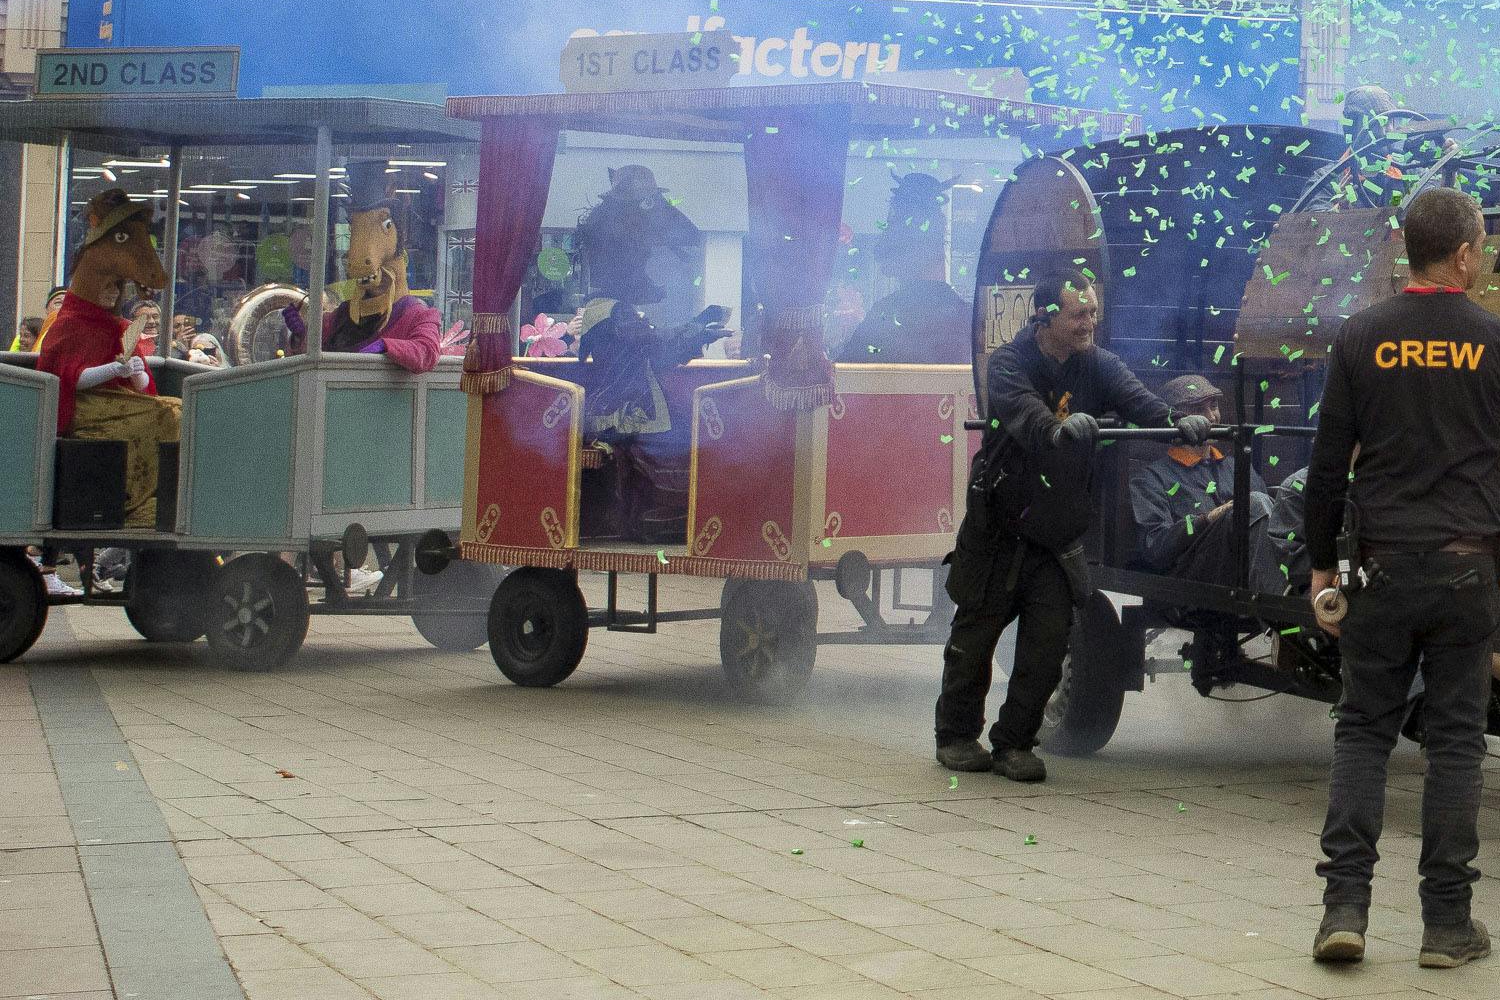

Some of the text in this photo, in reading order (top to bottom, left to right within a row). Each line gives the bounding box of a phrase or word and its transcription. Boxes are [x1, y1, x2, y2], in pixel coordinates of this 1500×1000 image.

[53, 61, 216, 86] 2ND CLASS
[576, 46, 721, 77] 1ST CLASS
[1375, 340, 1485, 371] CREW
